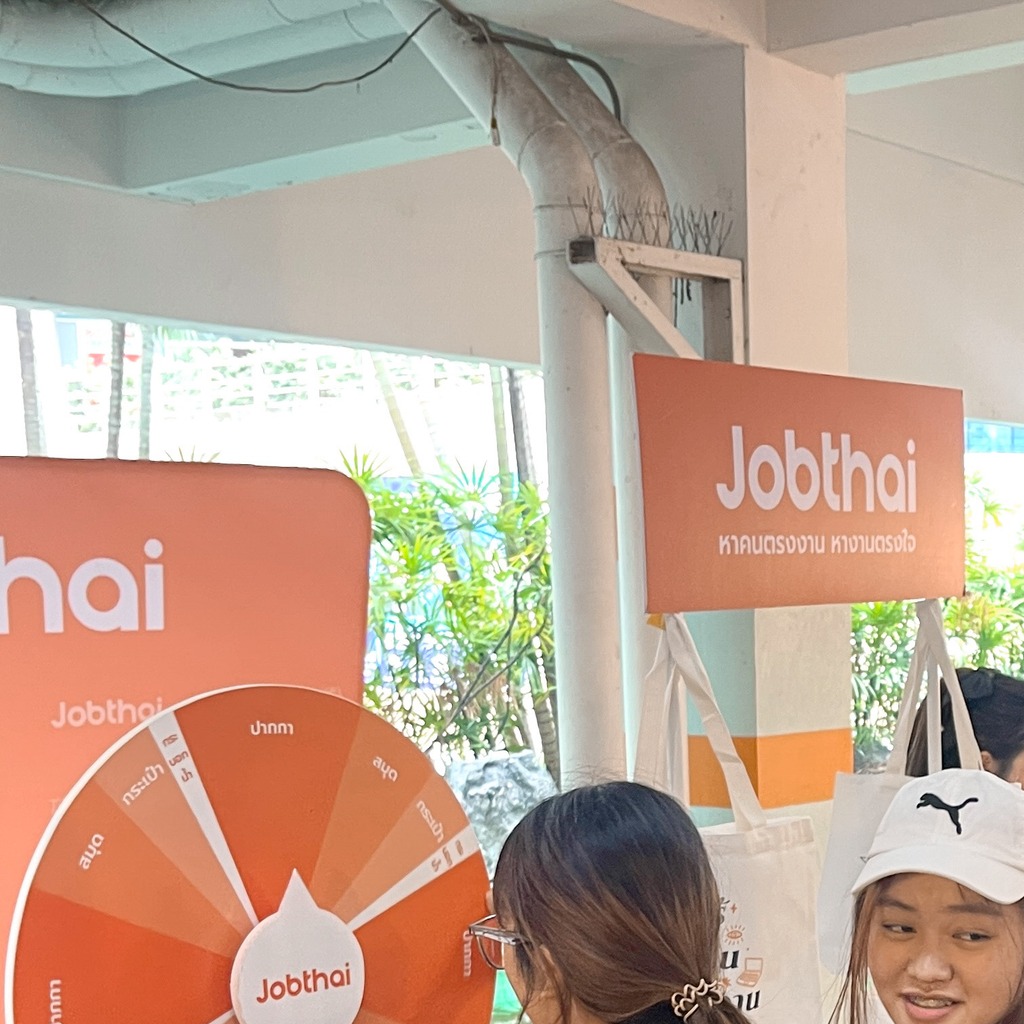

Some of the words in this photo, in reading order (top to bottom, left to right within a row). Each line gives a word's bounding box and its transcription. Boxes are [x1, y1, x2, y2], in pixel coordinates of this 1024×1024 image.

[716, 425, 917, 513] Jobthai
[718, 533, 825, 556] หาคนตรงงาน
[830, 528, 917, 554] หางานตรงใจ
[249, 719, 295, 737] ปากกา
[372, 756, 399, 783] สมุด
[78, 832, 106, 871] สมุด
[255, 962, 352, 1005] Jobthai
